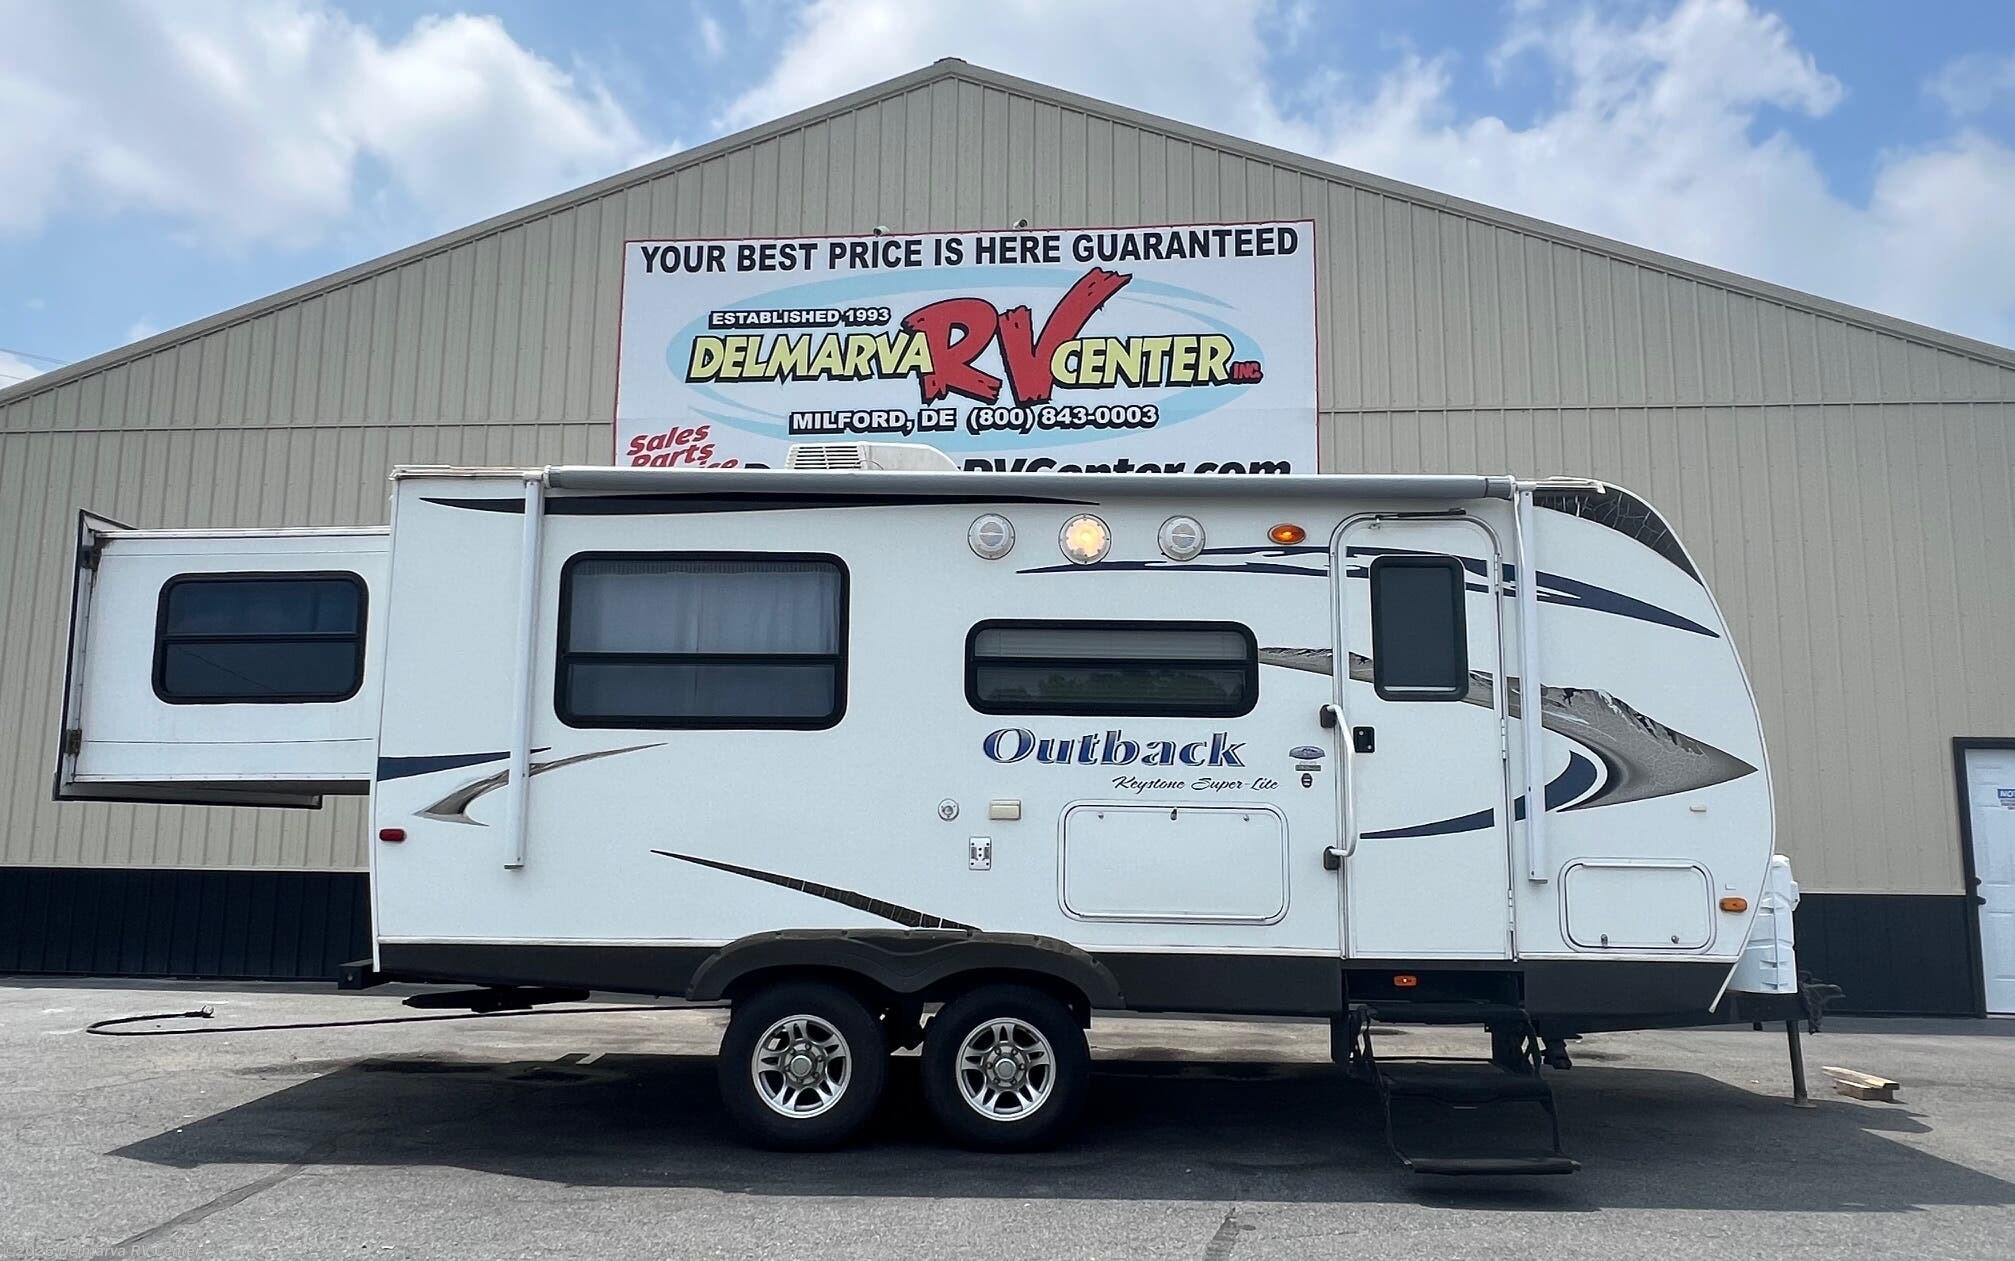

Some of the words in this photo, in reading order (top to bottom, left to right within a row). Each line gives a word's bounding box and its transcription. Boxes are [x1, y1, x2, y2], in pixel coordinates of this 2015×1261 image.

[641, 244, 726, 273] YOUR
[736, 243, 818, 271] BEST
[828, 239, 923, 270] PRICE
[934, 237, 964, 266] IS
[976, 235, 1061, 265] HERE
[1073, 227, 1298, 262] GUARANTEED
[711, 311, 840, 326] ESTABLISHED
[845, 307, 890, 323] 1993
[687, 332, 936, 382] DELMARVA
[901, 268, 1132, 405] RV
[1051, 335, 1233, 388] CENTER
[792, 411, 914, 433] MILFORD,
[920, 408, 956, 427] DE
[969, 407, 1034, 433] (800)
[1041, 406, 1159, 426] 843-0003
[627, 425, 711, 455] Sales
[983, 727, 1247, 767] Outback
[1111, 776, 1186, 795] Keystone
